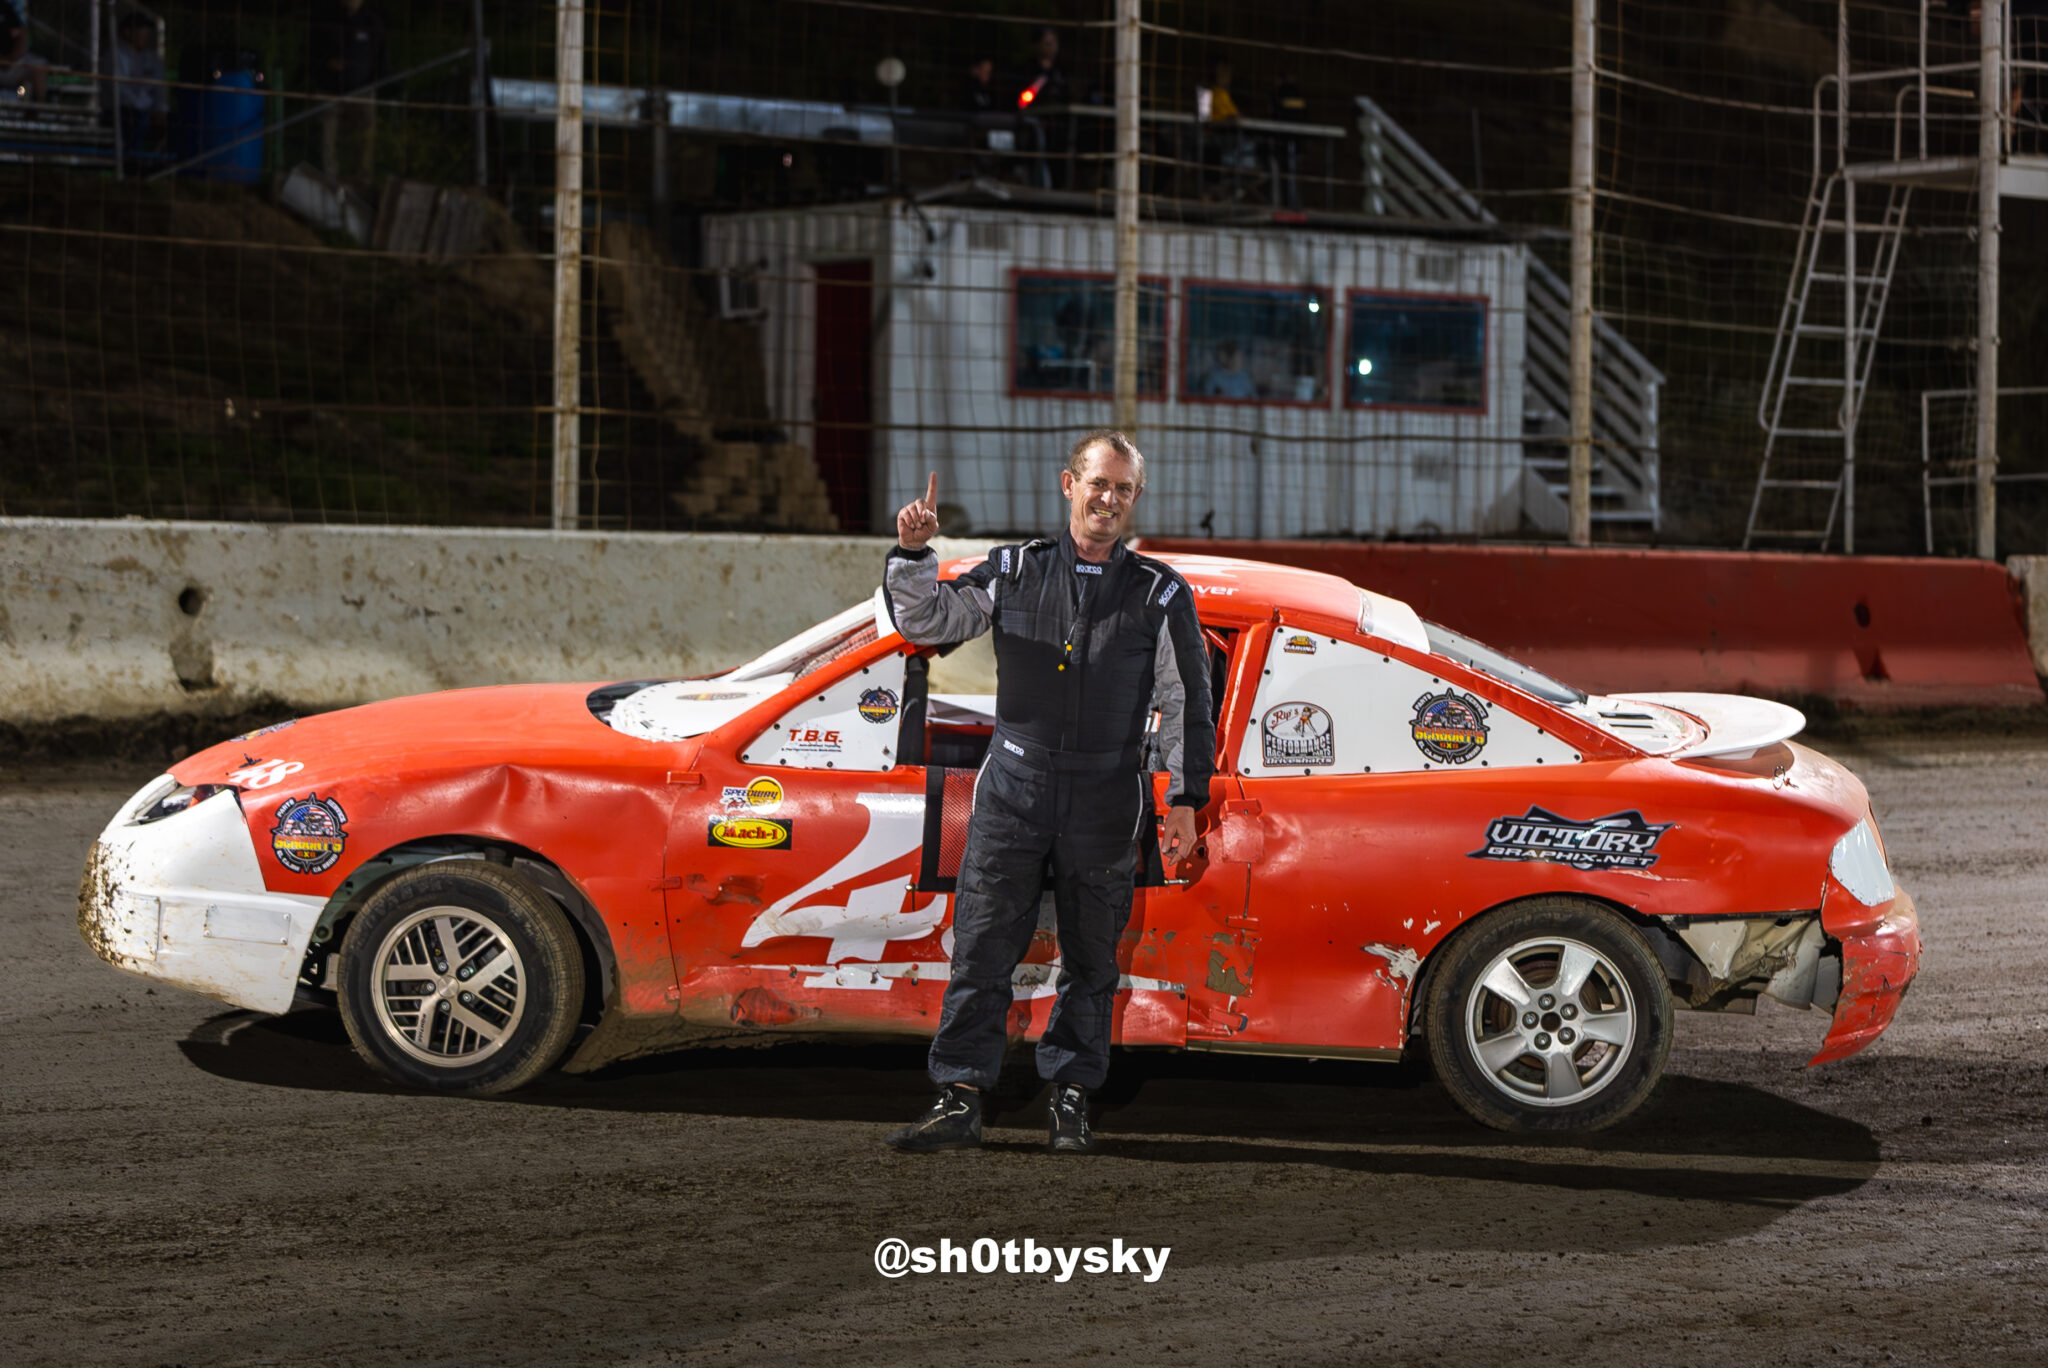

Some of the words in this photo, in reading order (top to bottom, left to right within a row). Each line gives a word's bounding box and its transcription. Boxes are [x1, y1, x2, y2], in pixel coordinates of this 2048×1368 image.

[789, 729, 843, 743] T.B.G.
[1265, 733, 1331, 754] PERFORMANCE
[721, 826, 778, 840] Mach-1
[1491, 823, 1656, 854] VICTORY
[1488, 846, 1654, 866] GRAPHIX.NET
